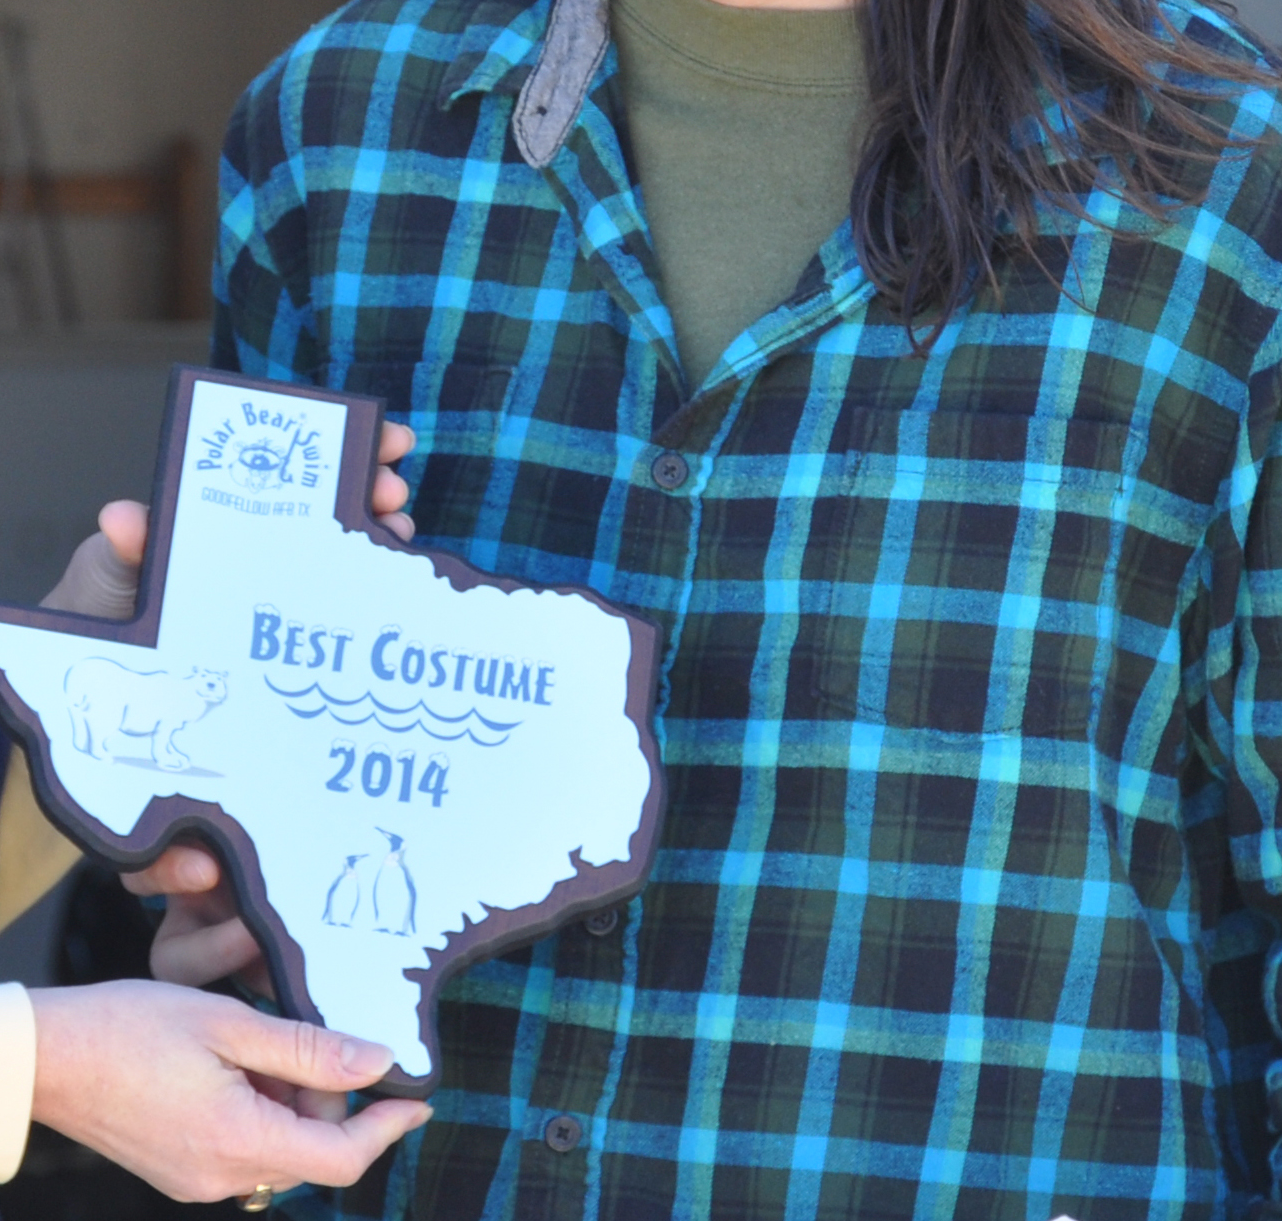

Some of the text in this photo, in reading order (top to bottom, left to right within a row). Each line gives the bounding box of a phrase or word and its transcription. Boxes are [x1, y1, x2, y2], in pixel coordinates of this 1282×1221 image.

[196, 402, 329, 489] Polar Bear Swim
[200, 486, 312, 518] GOODFELLOW AFB TX
[249, 603, 556, 706] BEST COSTUME
[325, 738, 451, 809] 2014
